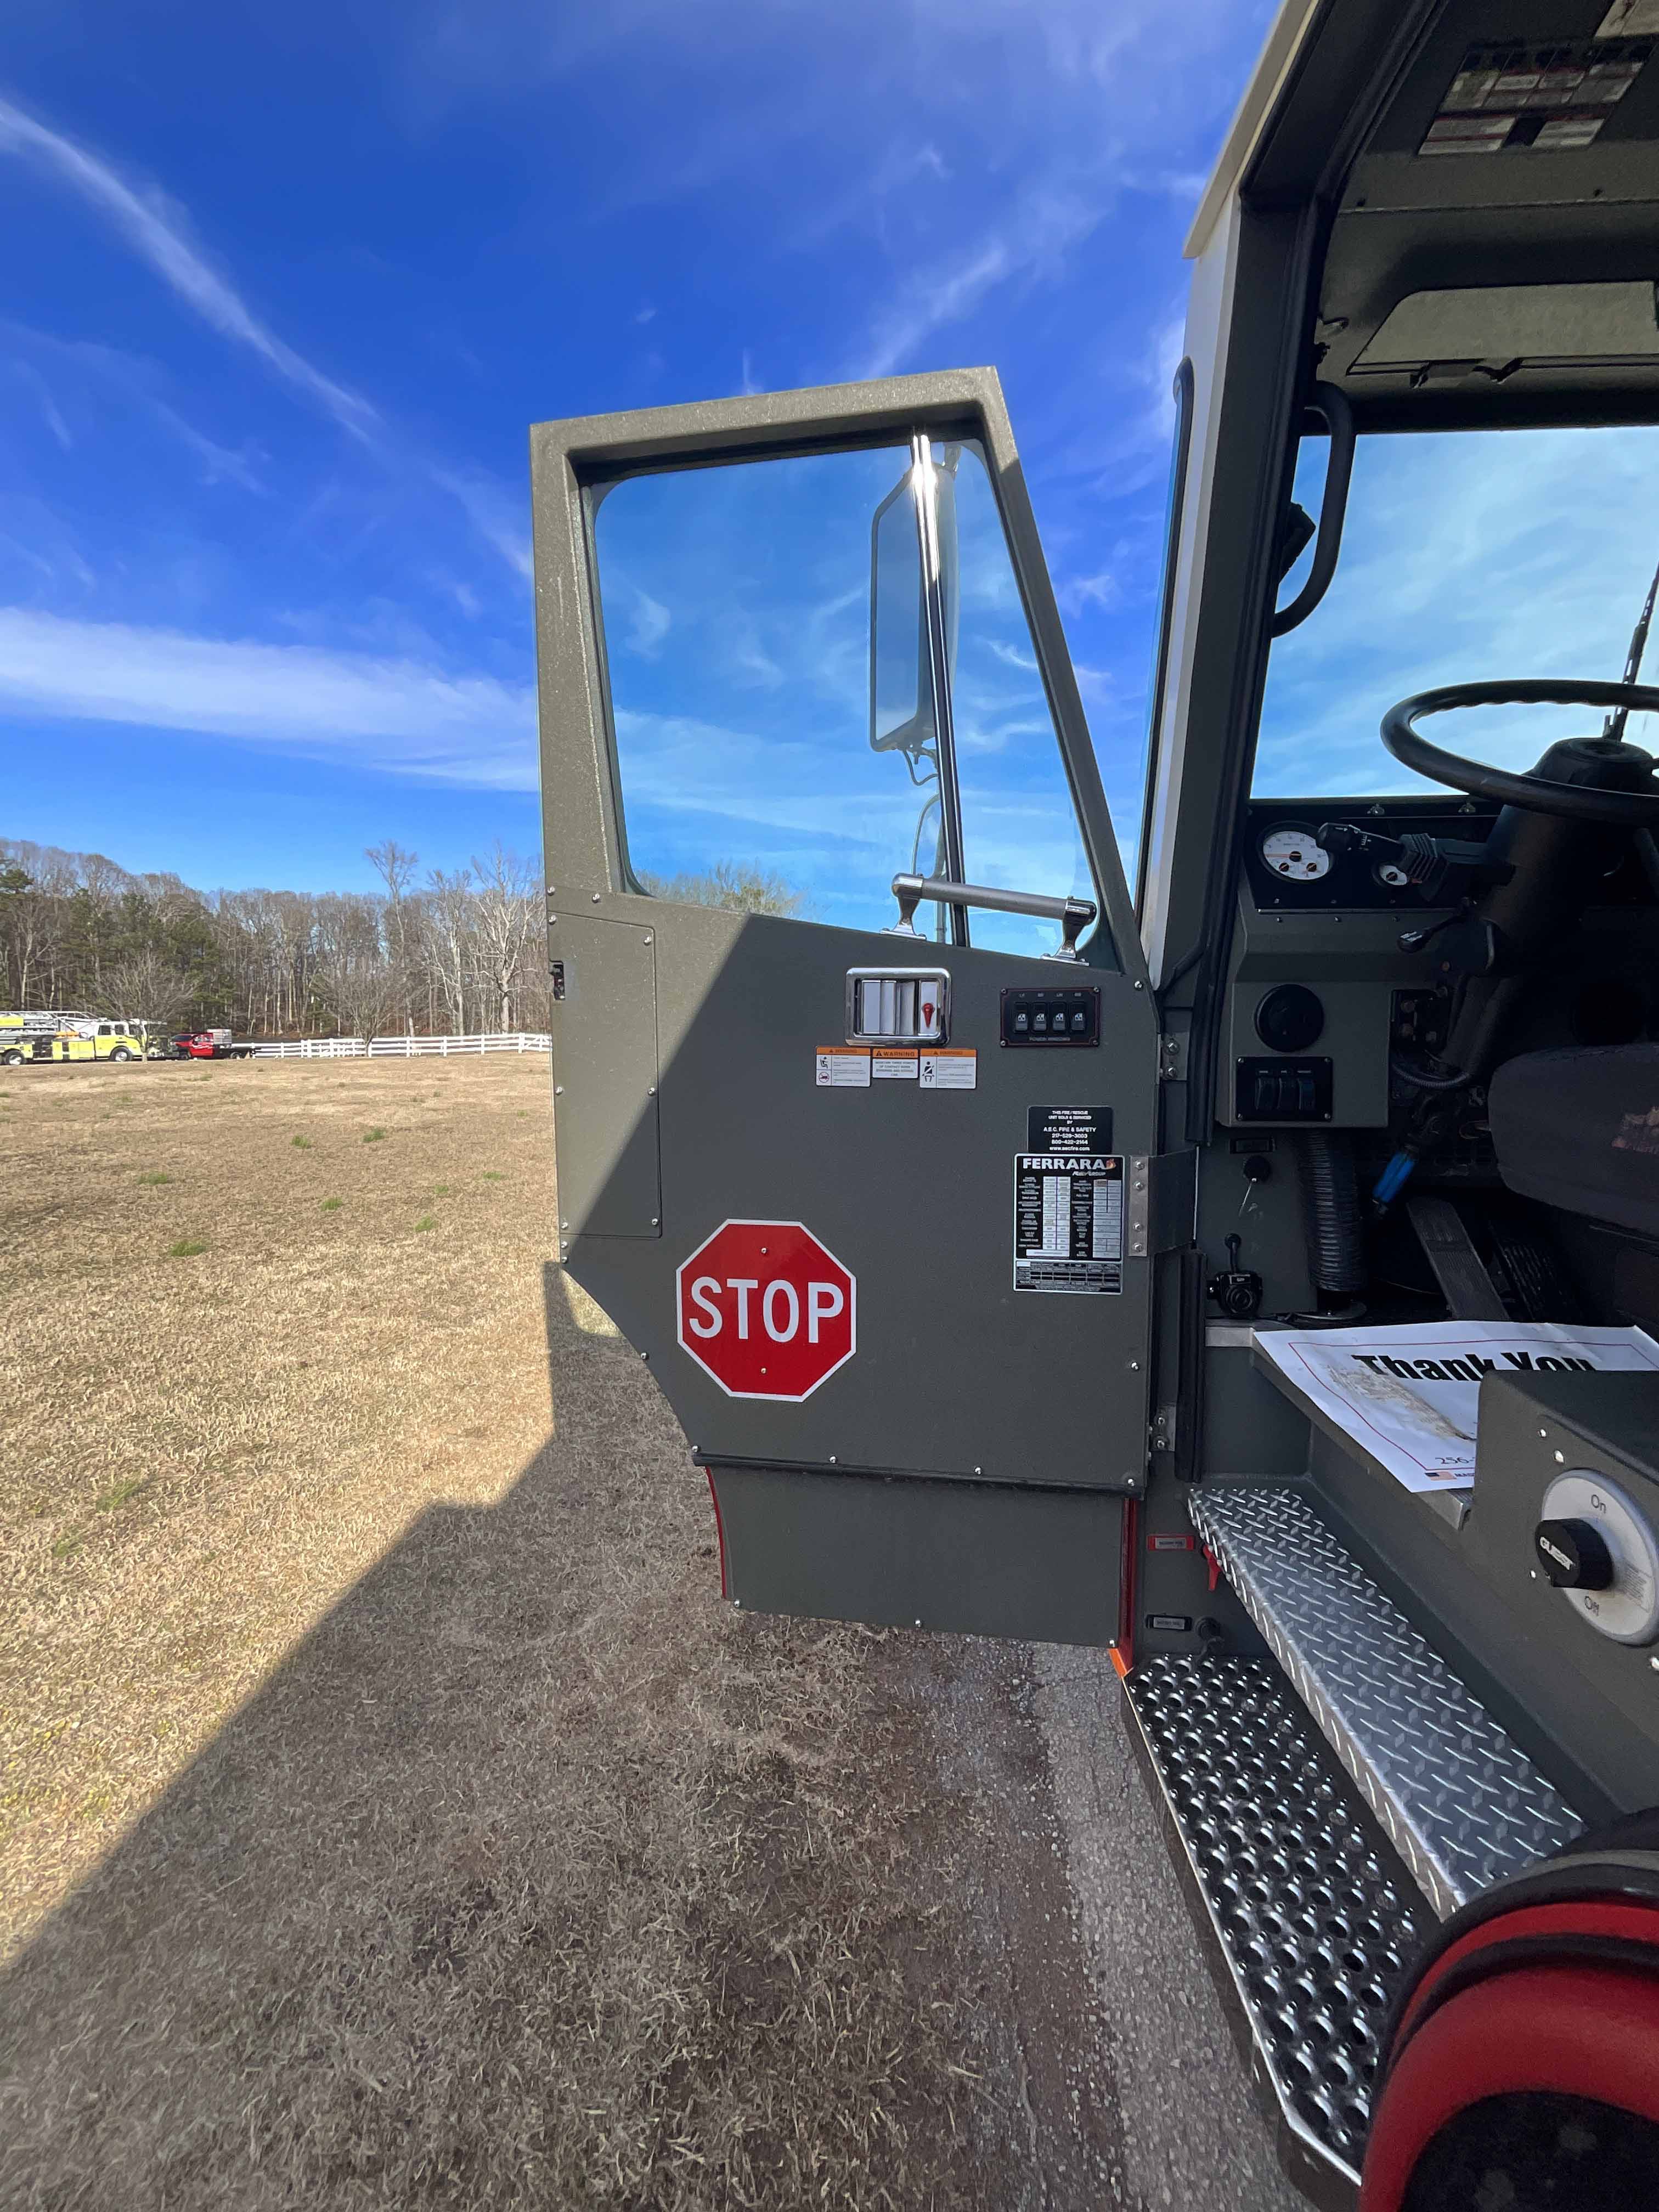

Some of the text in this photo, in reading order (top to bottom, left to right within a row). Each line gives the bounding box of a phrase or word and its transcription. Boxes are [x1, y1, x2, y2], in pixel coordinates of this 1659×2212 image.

[1023, 1158, 1108, 1170] FERRARA
[689, 1276, 844, 1344] STOP
[1351, 1351, 1596, 1382] Thank You
[1591, 1494, 1606, 1514] On
[1584, 1595, 1600, 1617] Off
